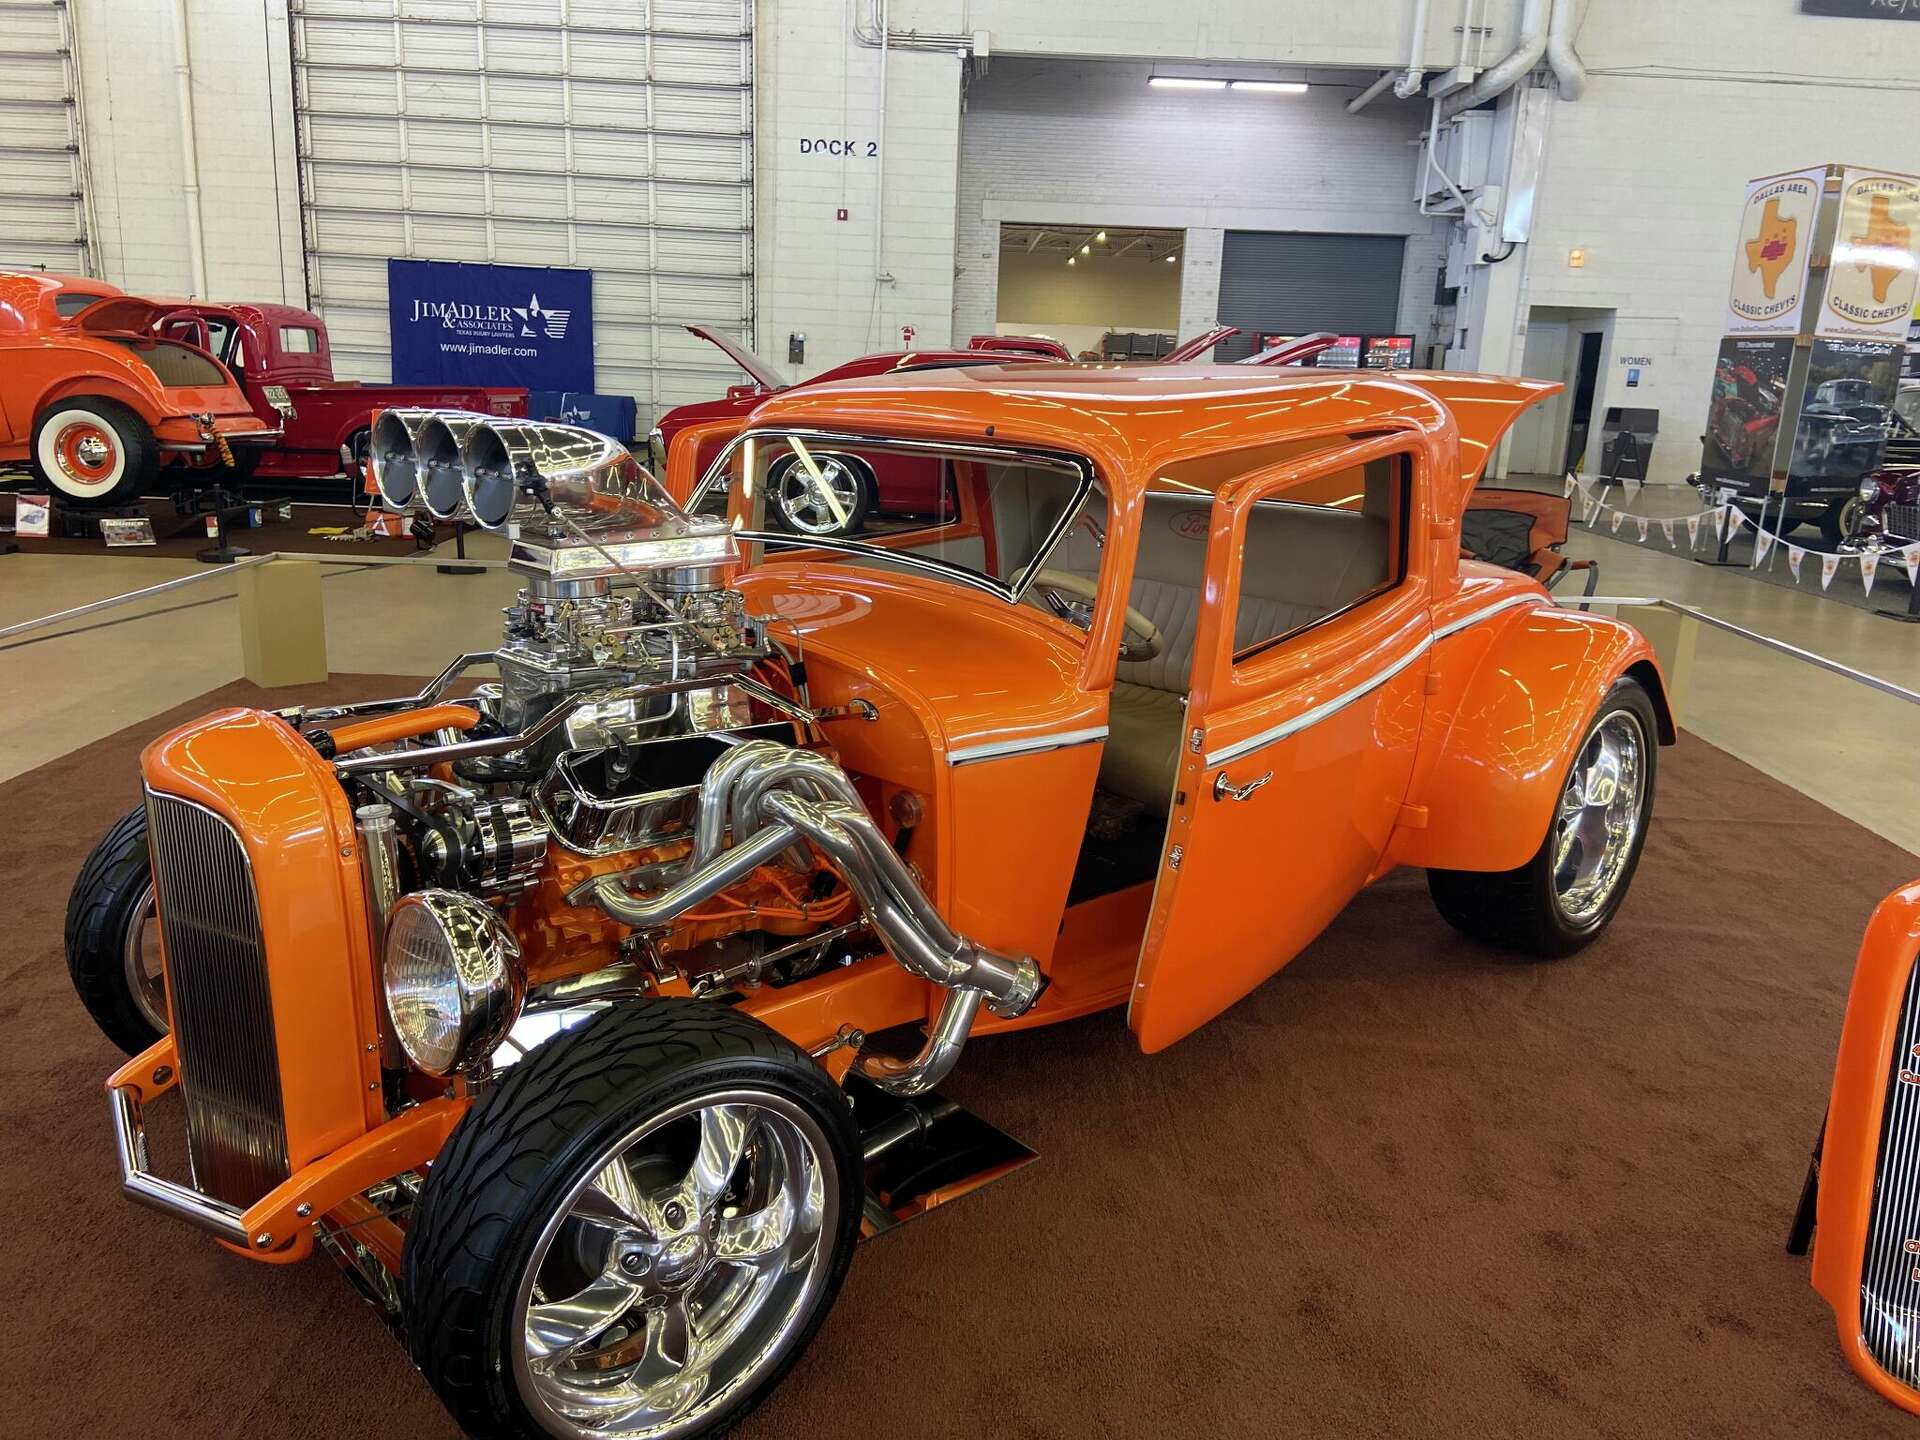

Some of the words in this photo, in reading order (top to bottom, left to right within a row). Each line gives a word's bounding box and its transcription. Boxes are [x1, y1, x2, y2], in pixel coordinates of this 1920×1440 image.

[800, 139, 856, 156] DOCK
[867, 142, 877, 157] 2
[1753, 183, 1785, 205] DALLAS
[1787, 183, 1808, 195] AREA
[1733, 298, 1762, 316] CLASSIC
[1764, 294, 1796, 315] CHEVYS
[1833, 296, 1869, 319] CLASSIC
[1871, 302, 1908, 319] CHEVYS
[443, 312, 456, 329] &
[457, 320, 514, 331] ASSOCIATES
[440, 342, 537, 357] www.jimadler.com
[1620, 356, 1652, 367] WOMEN
[1181, 513, 1209, 533] For
